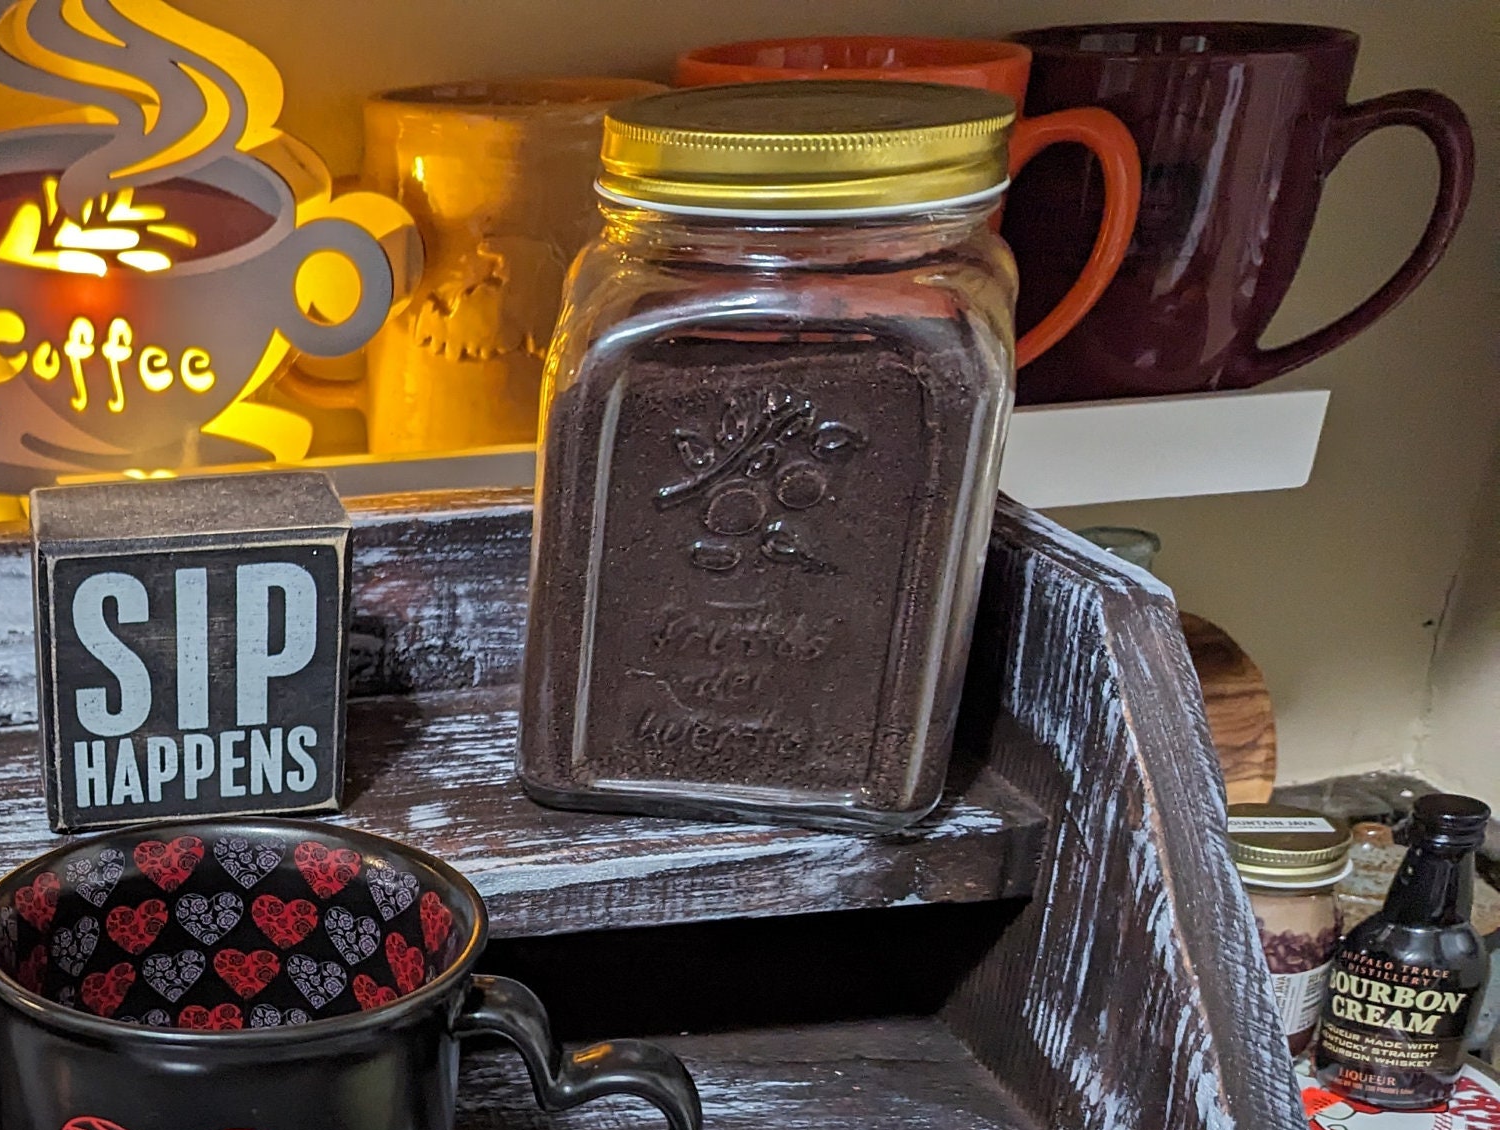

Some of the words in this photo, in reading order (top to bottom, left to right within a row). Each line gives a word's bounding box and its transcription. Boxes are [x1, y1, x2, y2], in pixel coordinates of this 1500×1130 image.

[71, 560, 319, 738] SIP
[73, 724, 319, 808] HAPPENS
[1348, 963, 1432, 986] DISTILLERY
[1402, 965, 1450, 978] TRACE
[1329, 968, 1467, 1014] BOURBON
[1332, 995, 1442, 1035] CREAM
[1323, 1022, 1361, 1041] IQUEUR
[1364, 1037, 1402, 1049] MADE
[1407, 1042, 1440, 1051] WITH
[1371, 1047, 1438, 1059] STRAIGHT
[1375, 1057, 1433, 1068] WHISKEY
[1338, 1067, 1397, 1086] LIQUEUR
